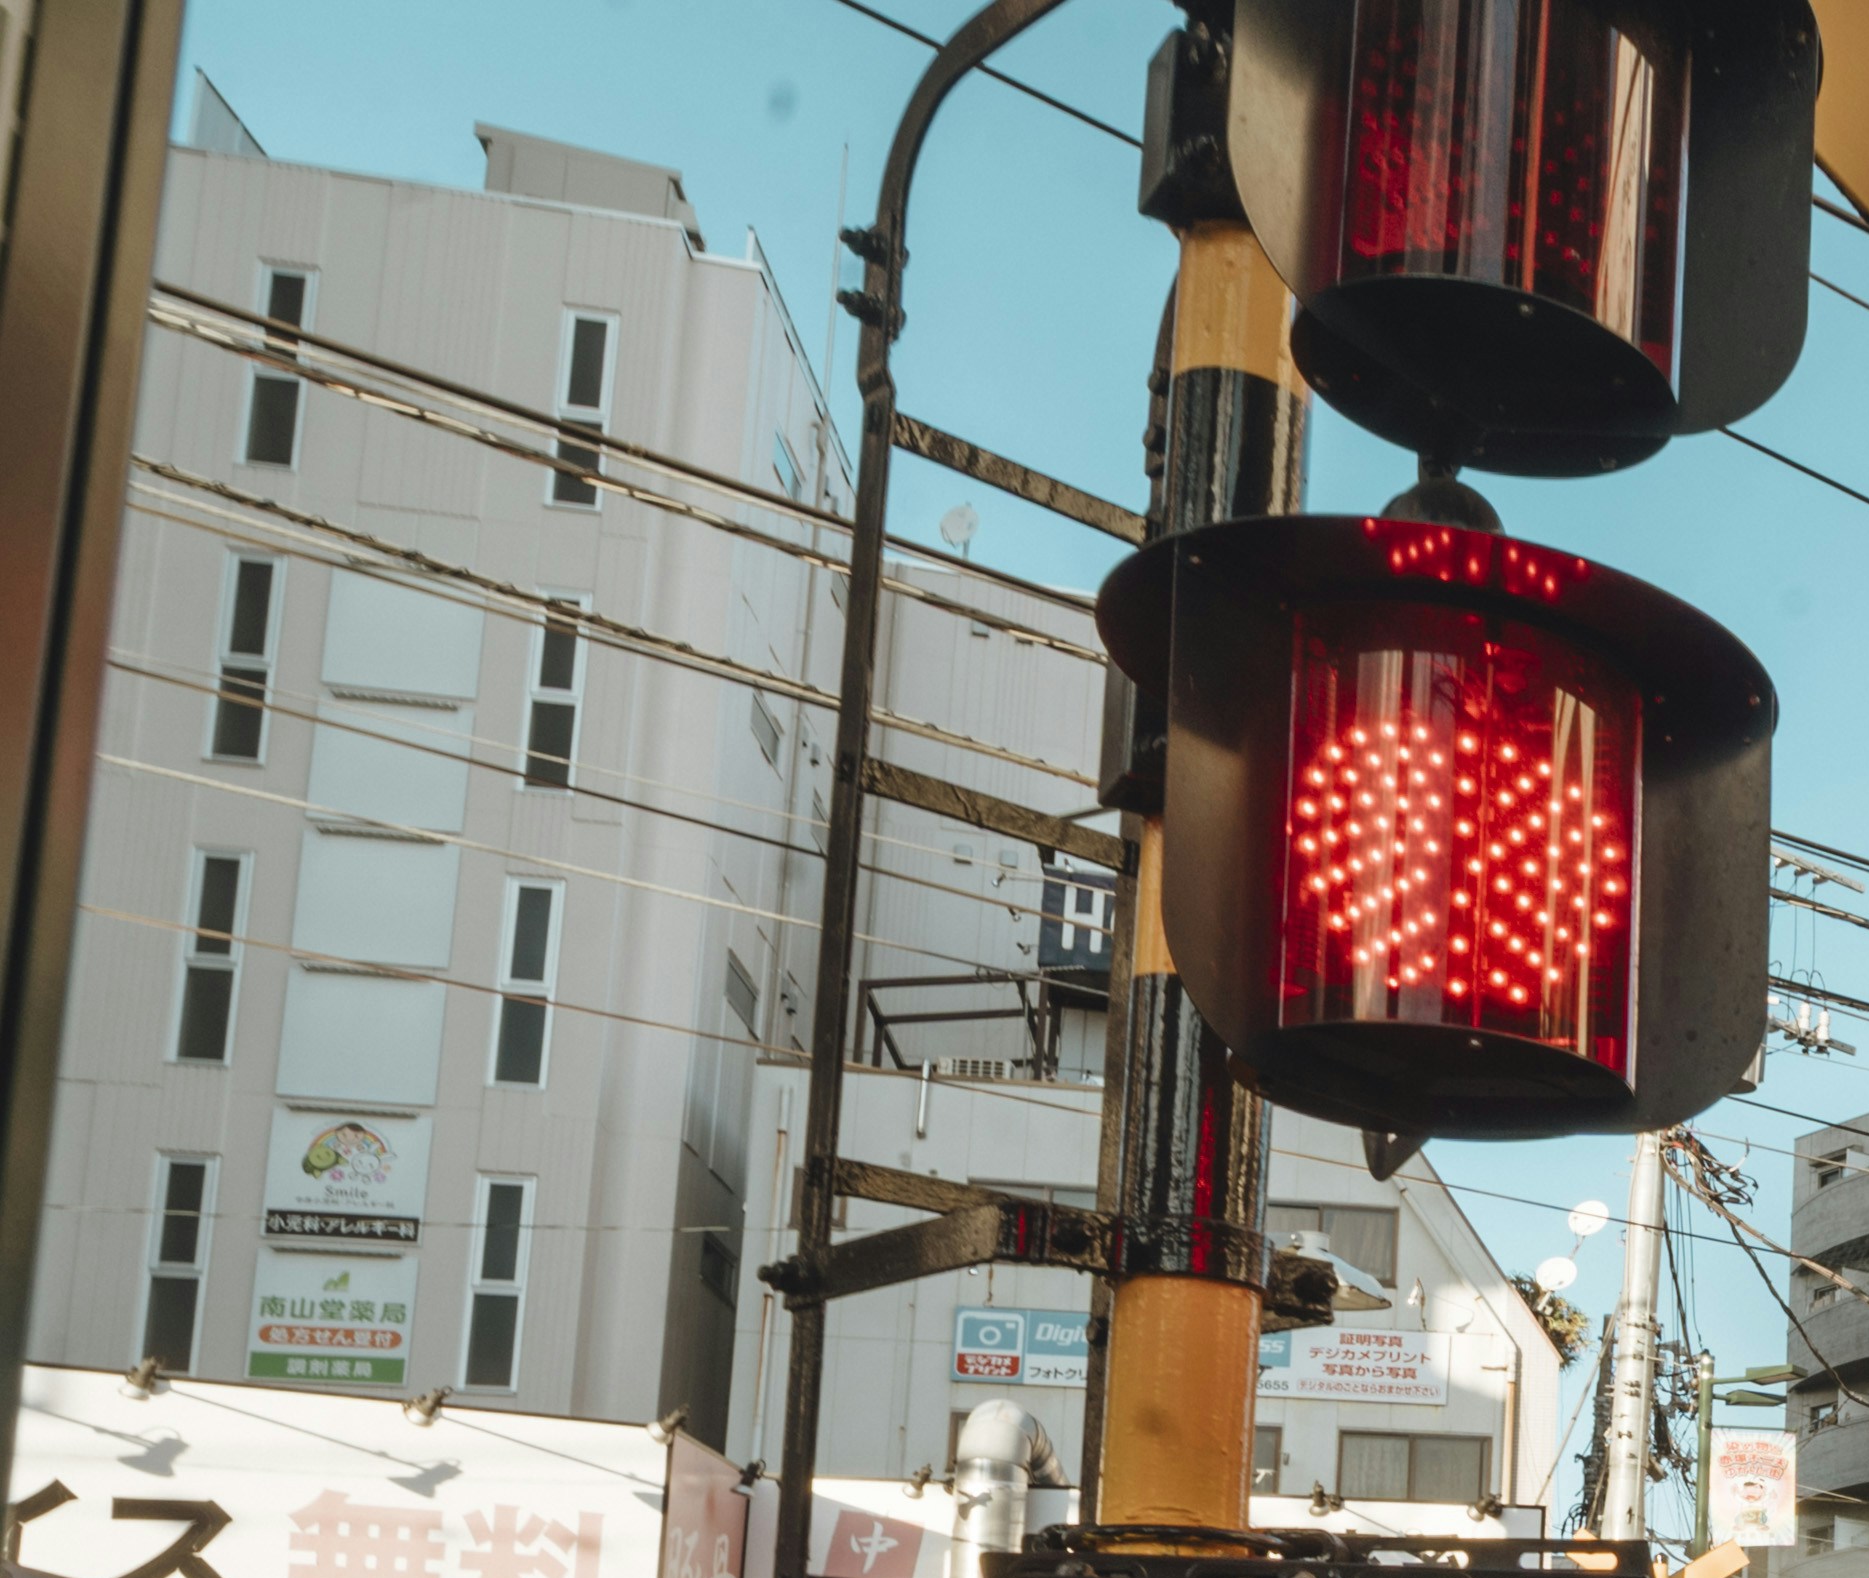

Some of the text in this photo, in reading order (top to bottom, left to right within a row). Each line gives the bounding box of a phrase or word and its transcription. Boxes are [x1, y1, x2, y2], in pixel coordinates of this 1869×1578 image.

[259, 1296, 408, 1325] 南山堂薬局
[268, 1326, 395, 1348] 処方せん受付
[1339, 1332, 1403, 1348] 証明写真
[1309, 1347, 1432, 1365] デジカメプリント
[286, 1357, 374, 1378] 調剤薬局
[1322, 1363, 1418, 1380] 写真から写真
